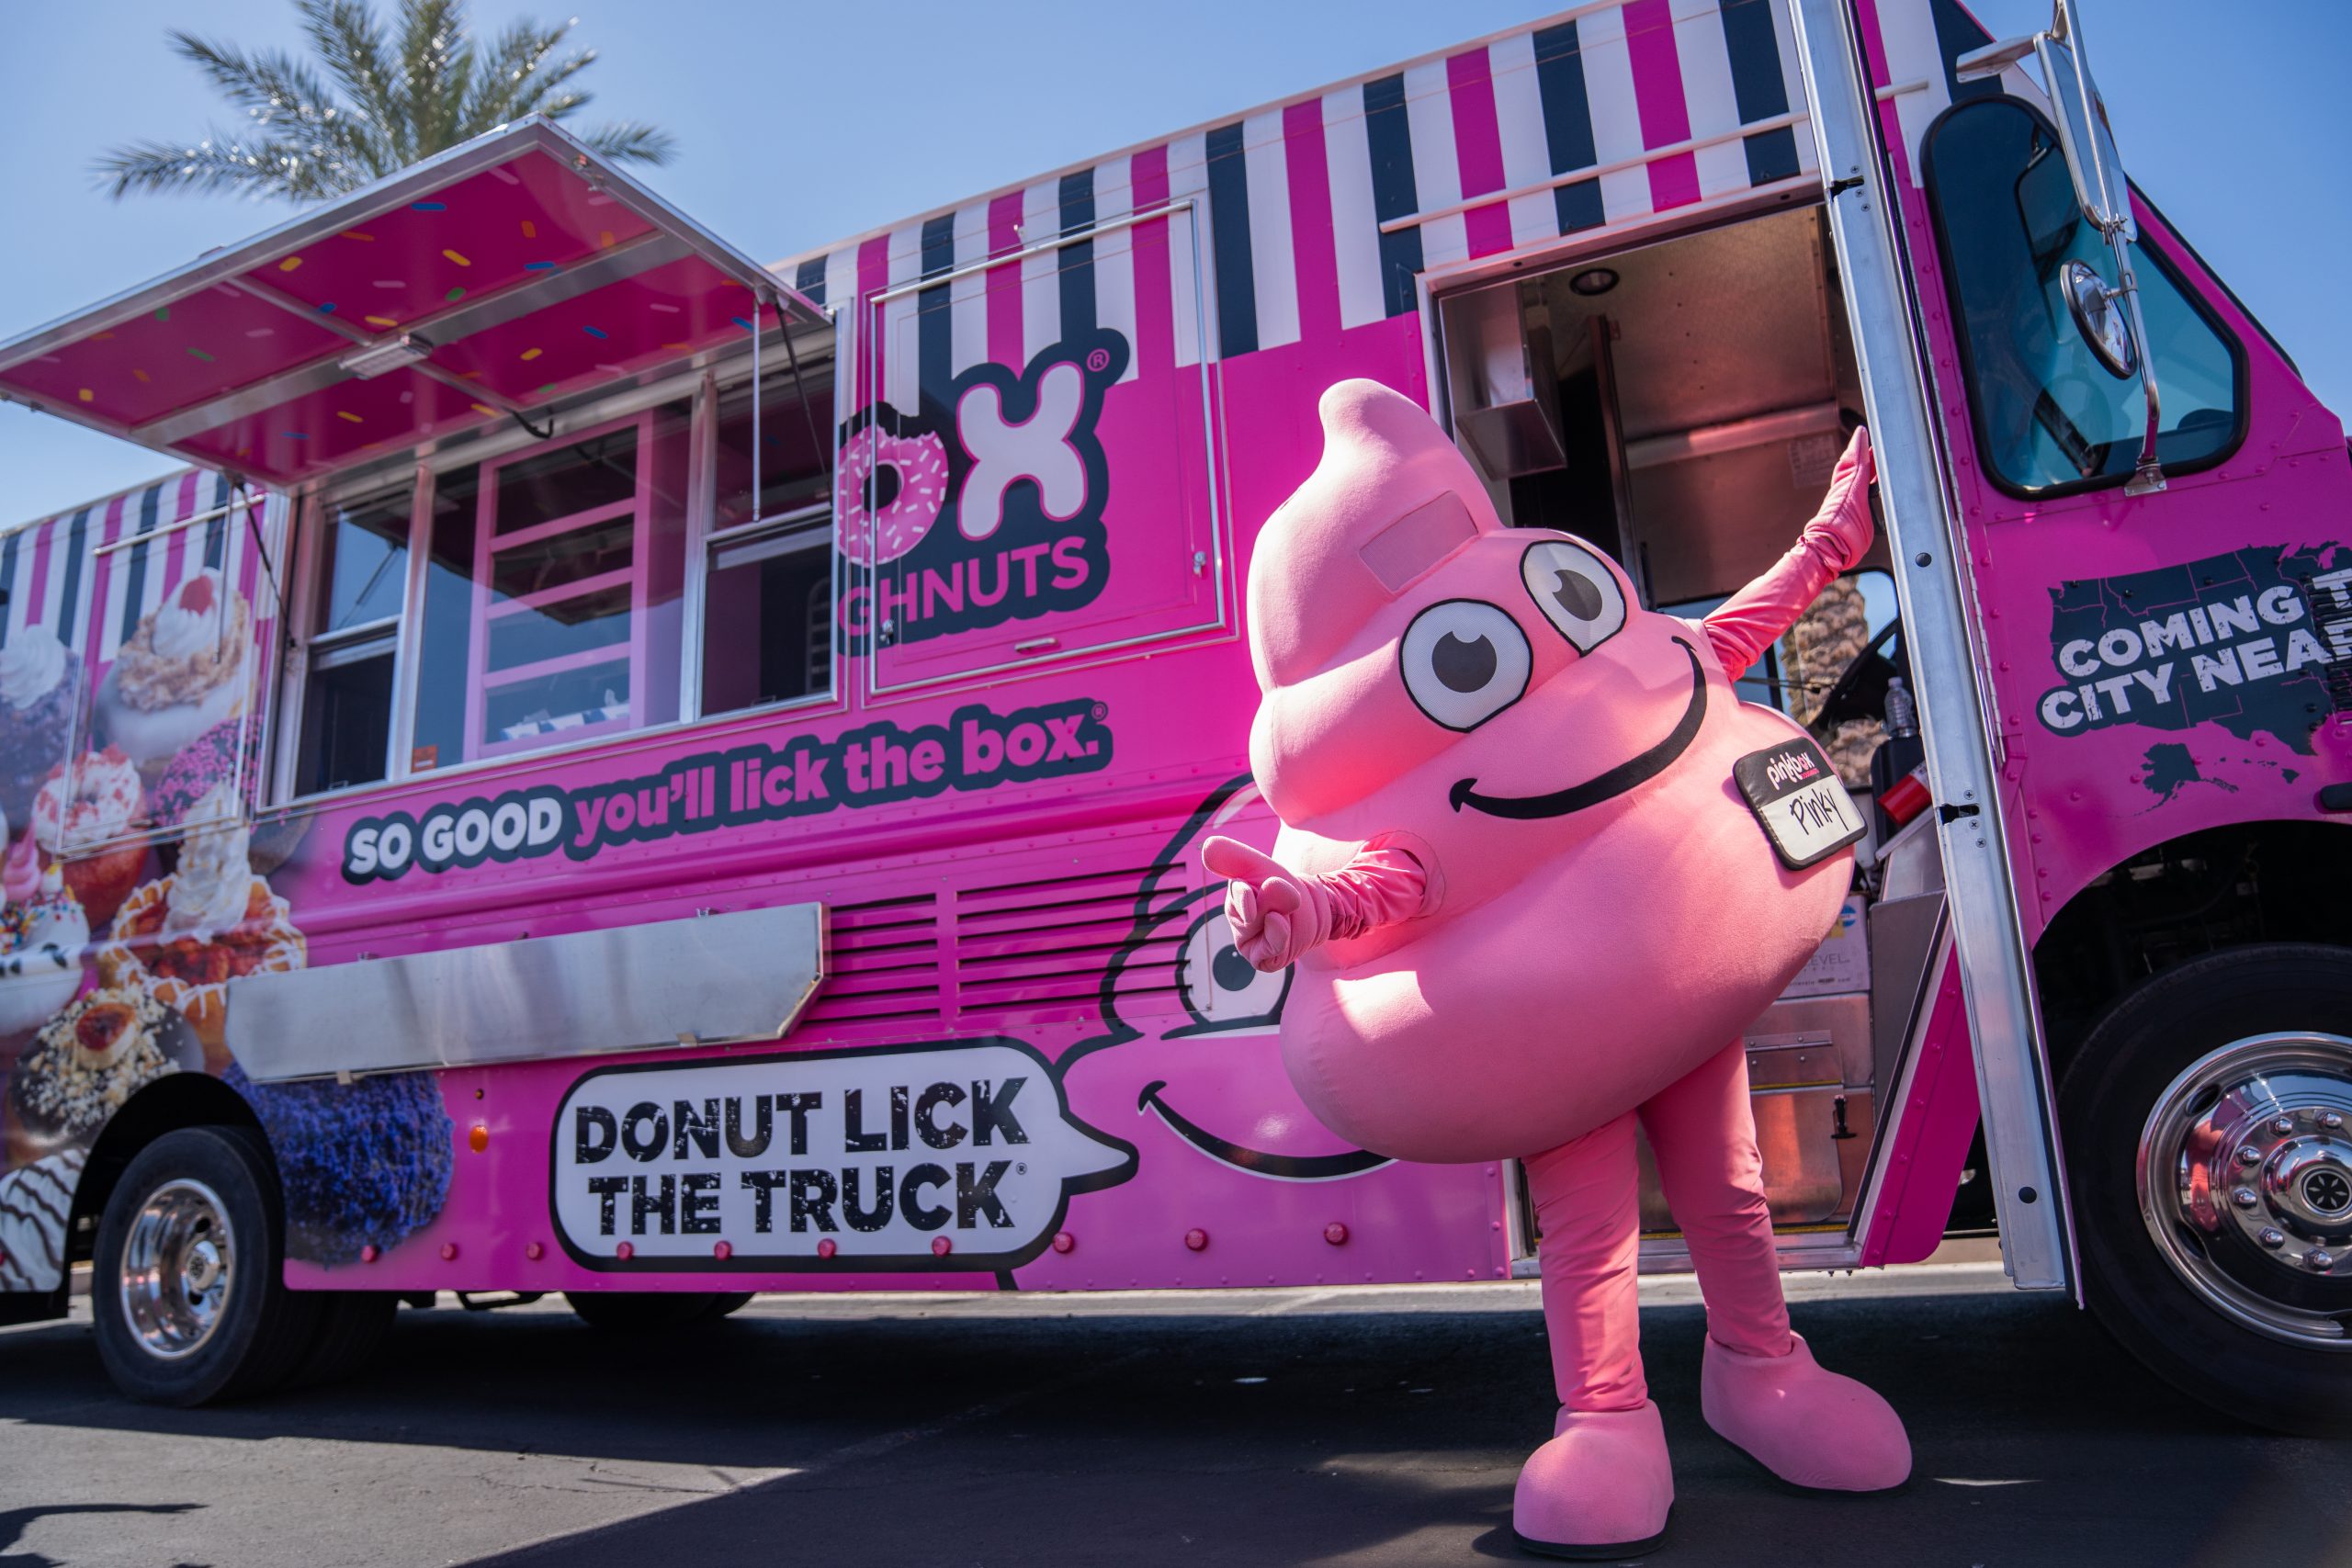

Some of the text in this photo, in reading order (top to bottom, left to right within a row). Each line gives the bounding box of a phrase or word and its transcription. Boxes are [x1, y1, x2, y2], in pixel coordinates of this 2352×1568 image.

[2059, 585, 2304, 678] COMING
[2041, 662, 2174, 728] CITY
[1766, 750, 1815, 790] pinkbox
[349, 823, 413, 874] SO
[422, 796, 562, 863] GOOD
[730, 749, 830, 813] lick
[843, 736, 945, 794] the
[1789, 788, 1849, 835] Pinky
[575, 1077, 1031, 1165] DONUT LICK
[587, 1172, 722, 1235] THE
